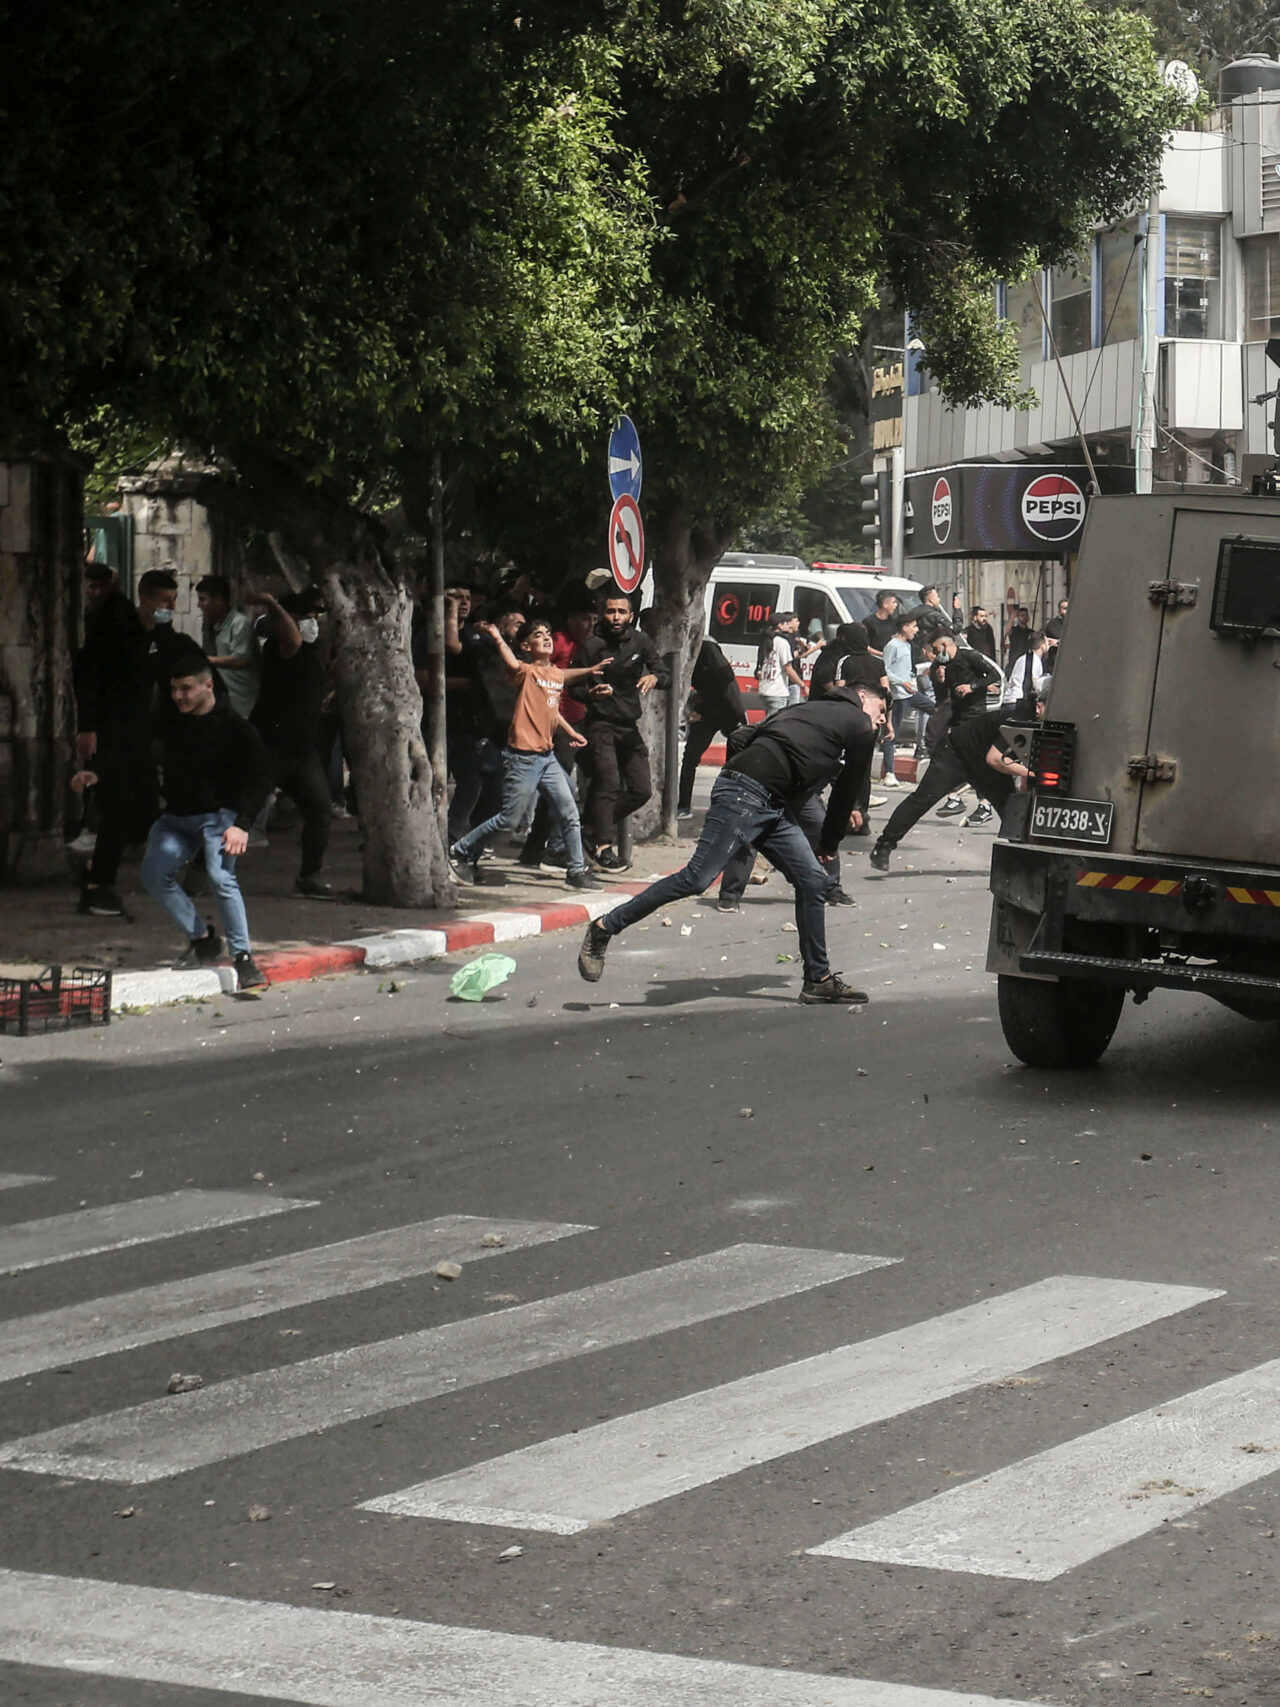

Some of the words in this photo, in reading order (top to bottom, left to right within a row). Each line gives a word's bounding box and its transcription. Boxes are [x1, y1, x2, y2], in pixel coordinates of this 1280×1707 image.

[933, 502, 951, 518] PEPSI
[1026, 501, 1081, 514] PEPSI
[748, 605, 770, 621] 101
